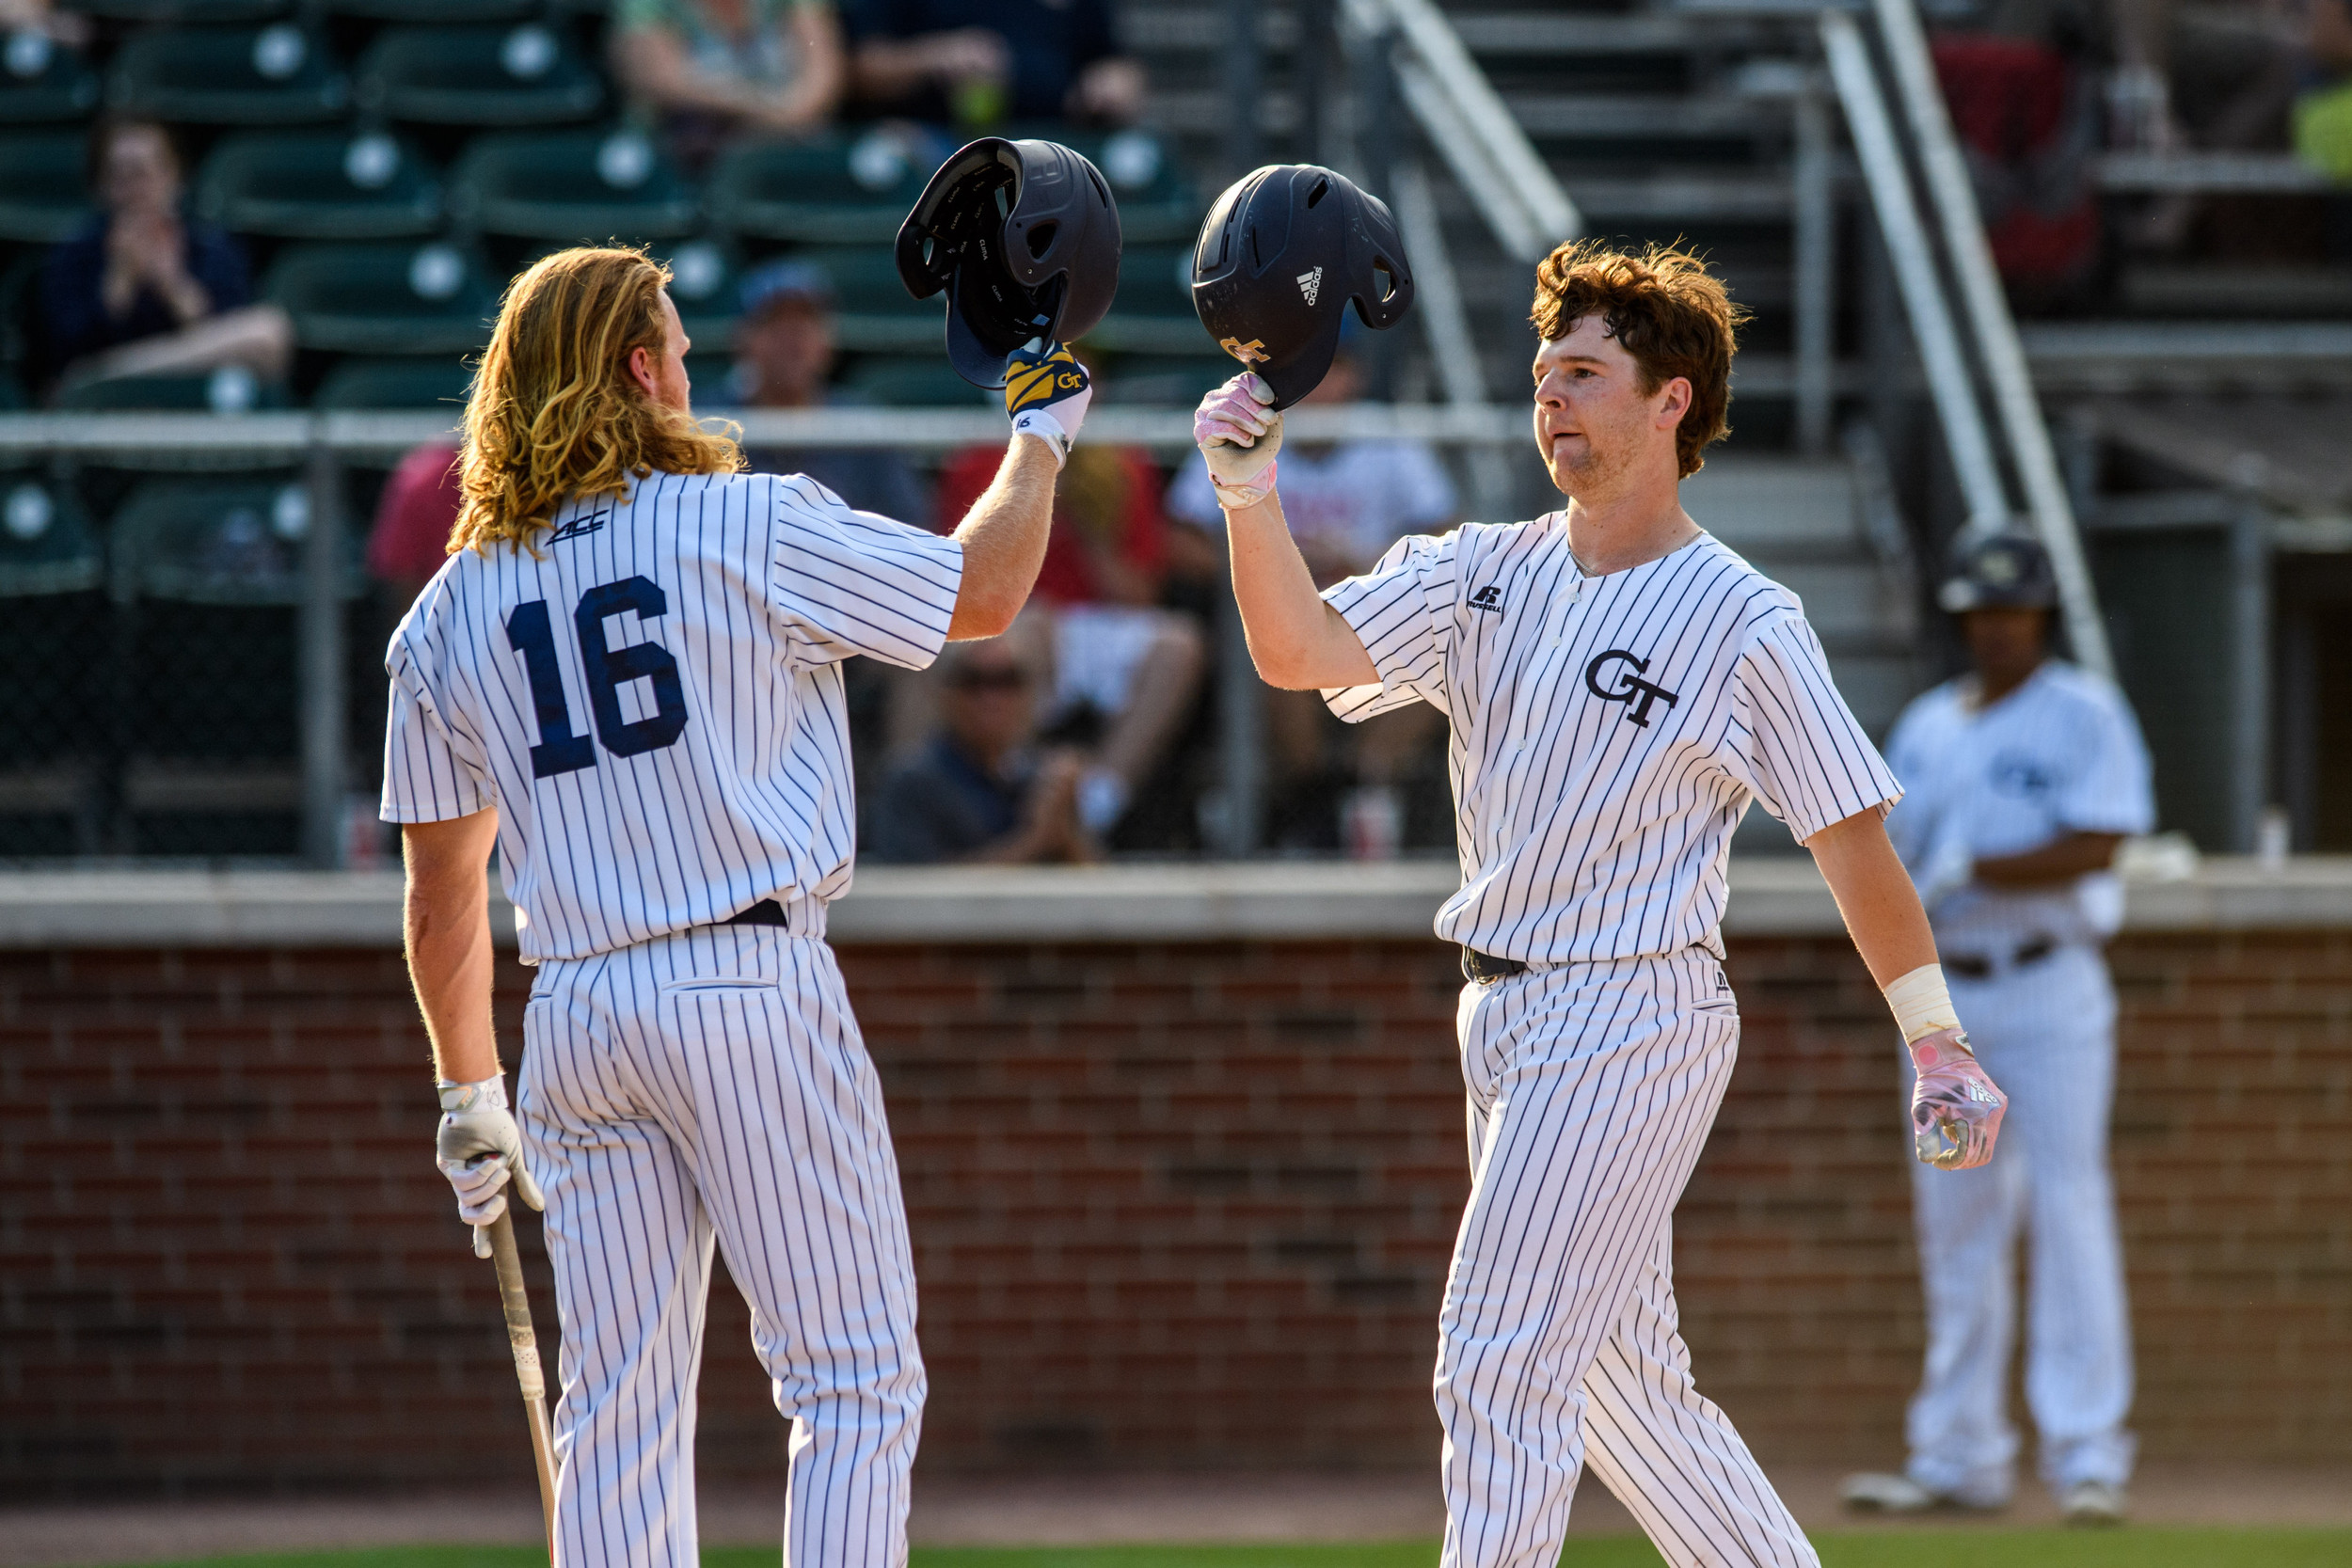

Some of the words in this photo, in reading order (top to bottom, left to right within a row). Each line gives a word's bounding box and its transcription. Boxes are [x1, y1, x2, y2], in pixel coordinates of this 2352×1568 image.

[979, 239, 989, 261] CLIMA
[1308, 266, 1323, 307] adidas
[1057, 372, 1081, 388] GT
[1016, 417, 1030, 431] 16
[545, 510, 610, 546] ACC
[1468, 600, 1501, 613] RUSSELL
[506, 575, 689, 780] 16
[1585, 649, 1679, 728] GT
